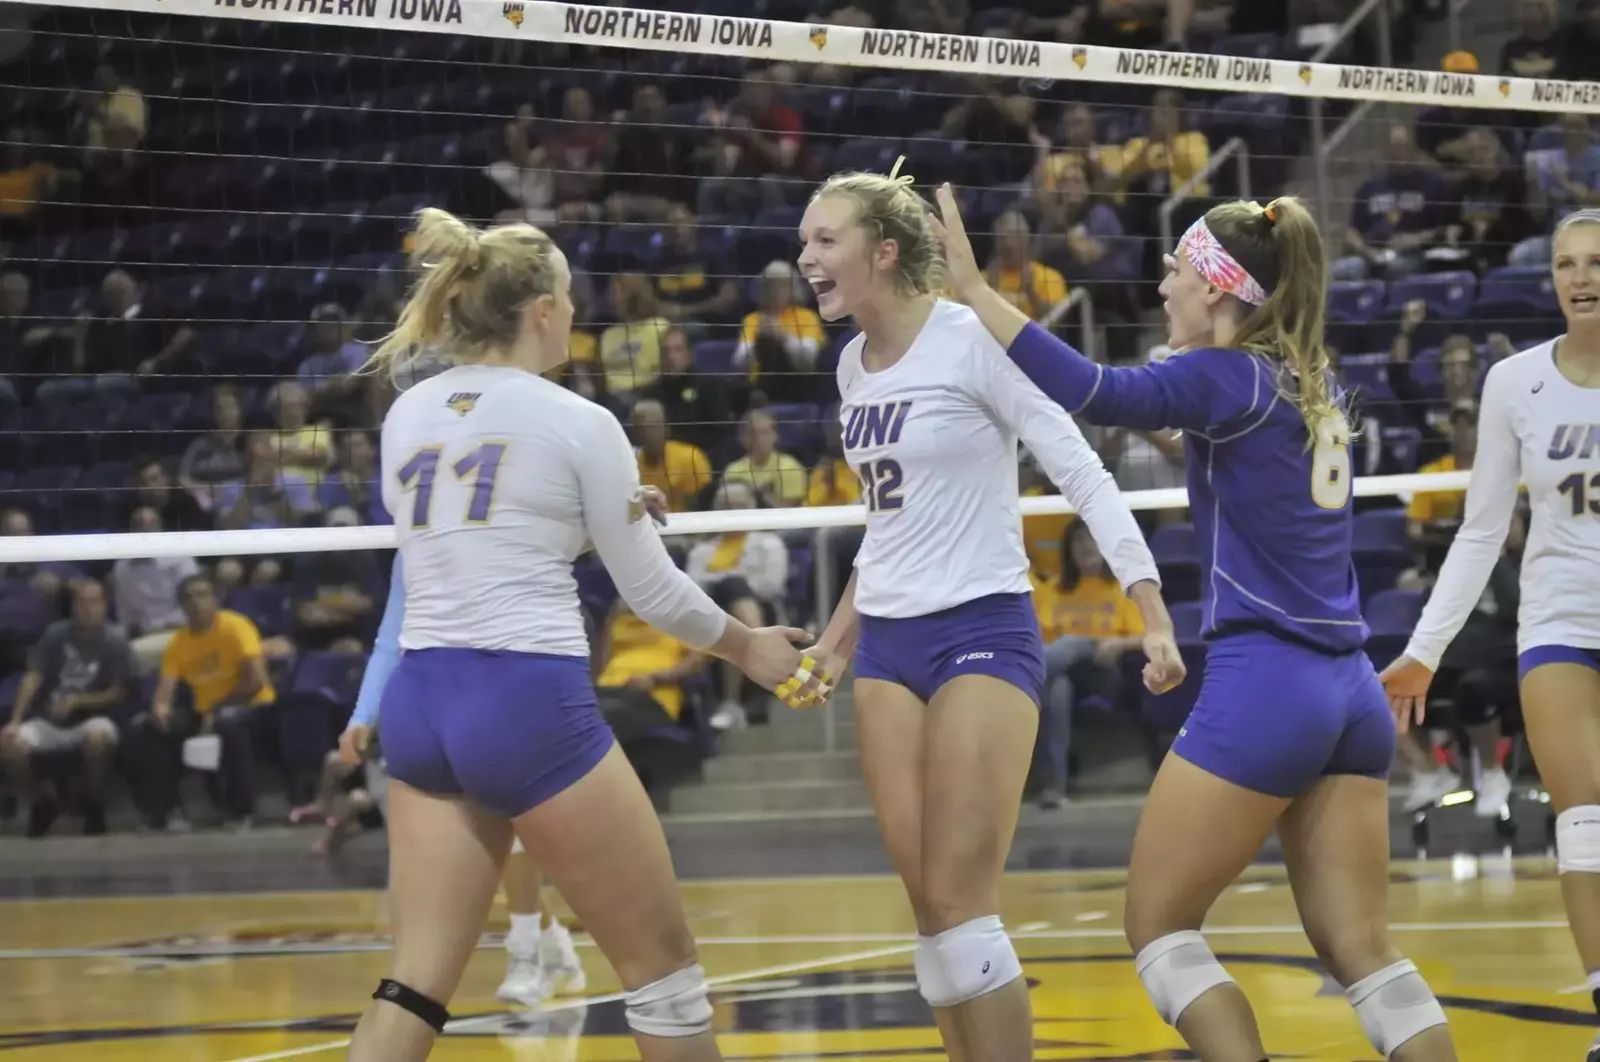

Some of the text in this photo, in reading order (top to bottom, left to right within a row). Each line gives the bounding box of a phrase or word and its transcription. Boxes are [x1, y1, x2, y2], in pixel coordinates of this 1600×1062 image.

[215, 0, 463, 24] HERN IOWA
[565, 7, 773, 48] NORTHERN IOWA
[861, 31, 1041, 67] NORTHERN IOWA
[1116, 51, 1273, 84] NORTHERN IOWA
[1338, 69, 1476, 97] NORTHERN IOWA
[845, 401, 913, 450] UNI
[1312, 406, 1350, 509] 6
[395, 440, 511, 531] 11
[859, 458, 904, 512] 12
